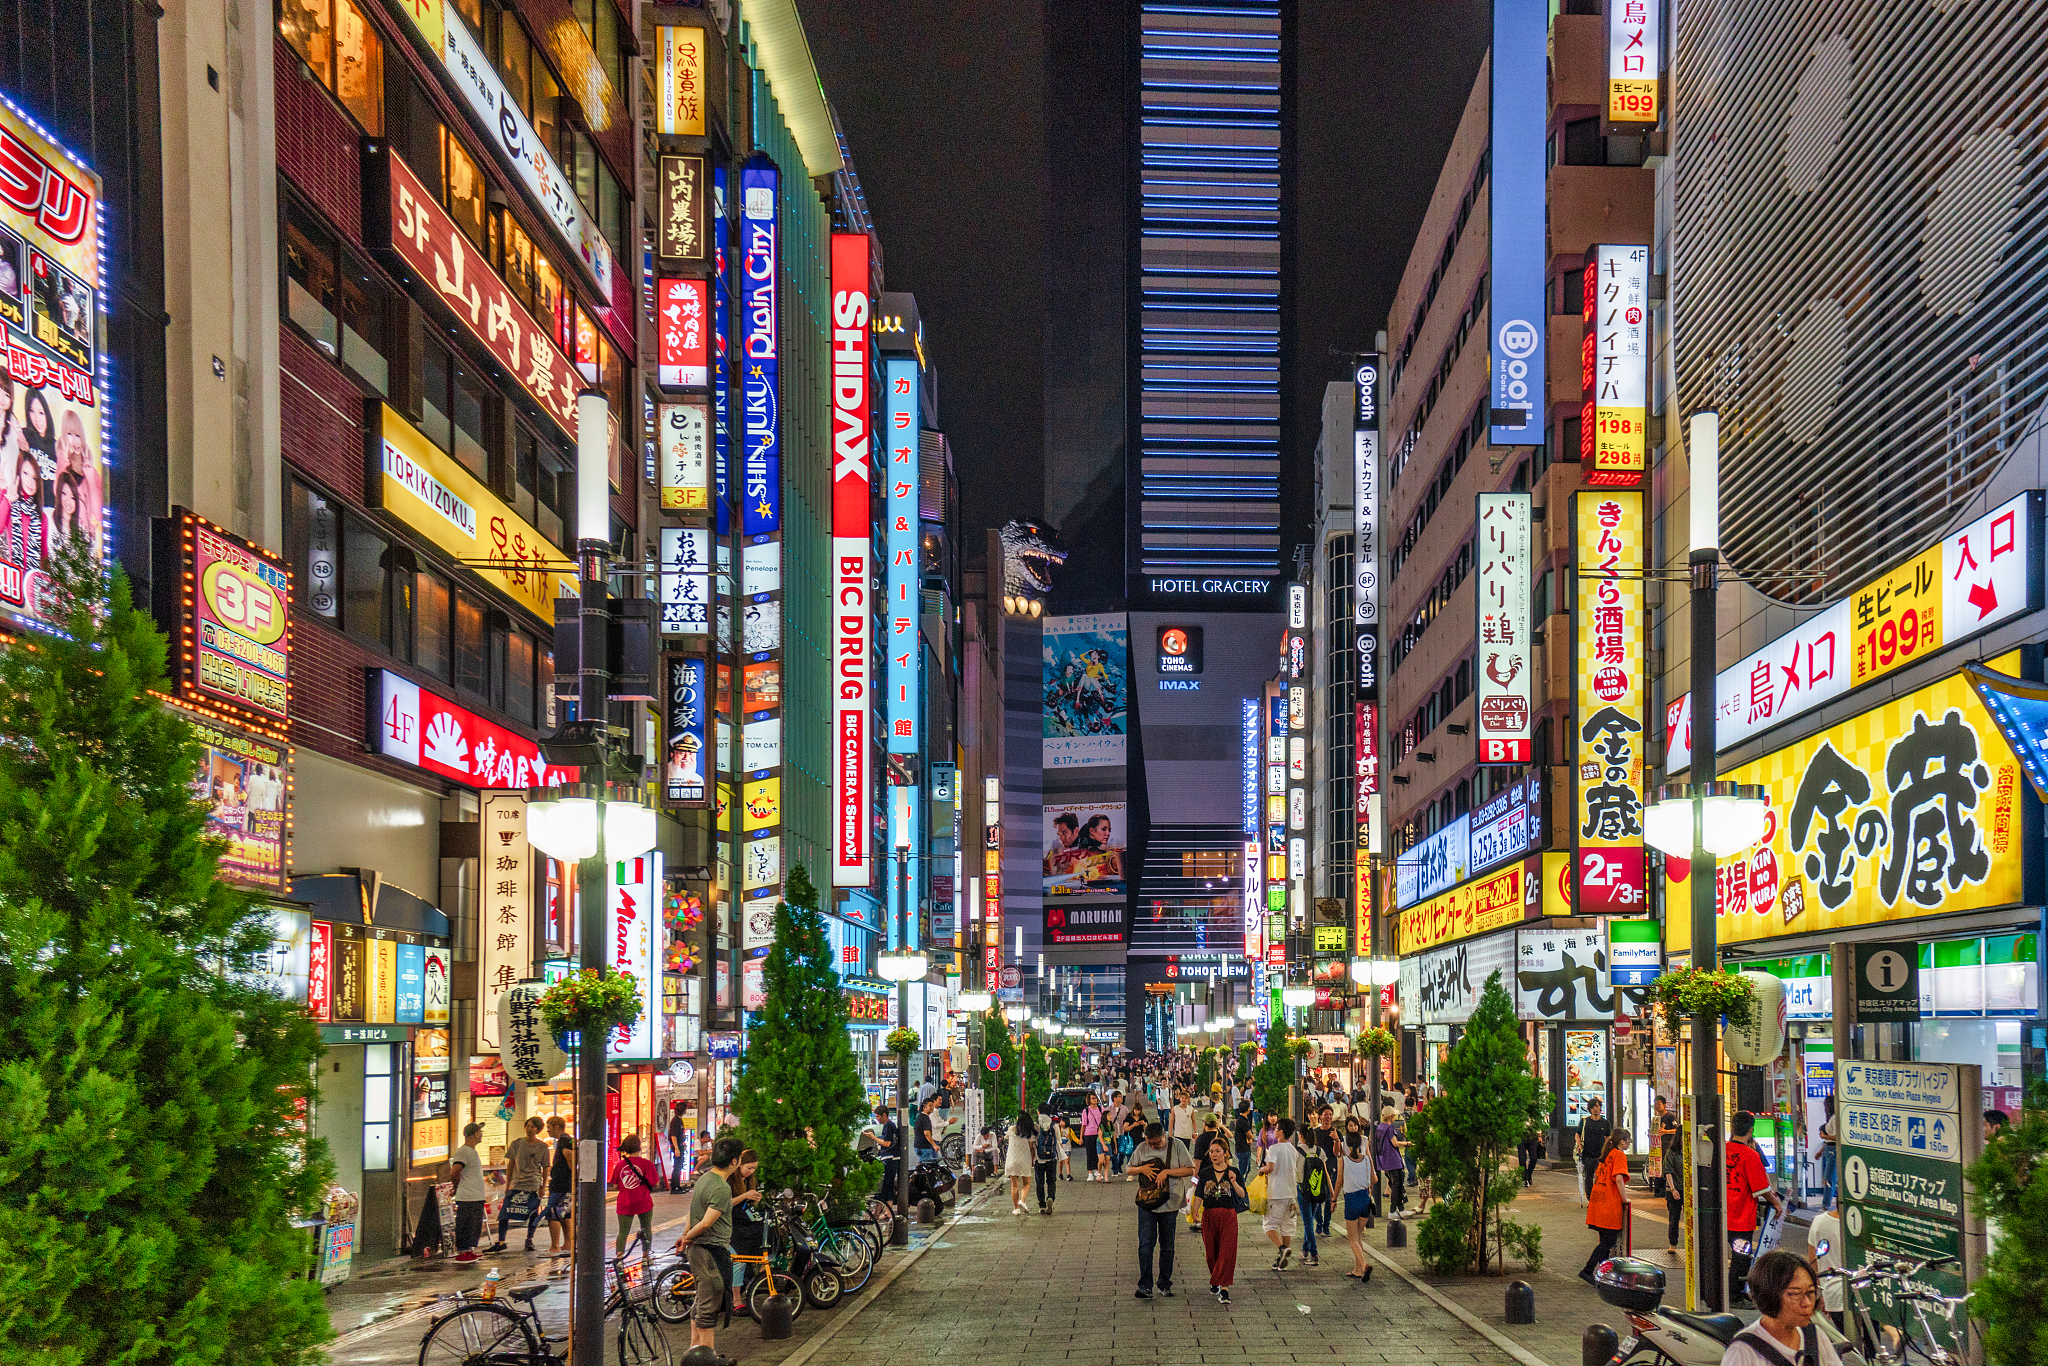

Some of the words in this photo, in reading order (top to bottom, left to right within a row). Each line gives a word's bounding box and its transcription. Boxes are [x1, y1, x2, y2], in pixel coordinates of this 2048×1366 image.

[1623, 1, 1647, 73] 鳥メロ
[1613, 83, 1653, 94] 生ビール
[1619, 95, 1653, 111] 199
[399, 184, 429, 253] 5F
[667, 160, 697, 245] 山内農場
[675, 244, 690, 256] 5F
[1629, 250, 1646, 263] 4F
[683, 300, 701, 350] 焼肉屋
[1601, 258, 1621, 400] キタノイチバ
[673, 368, 693, 384] 4F
[834, 290, 868, 483] SHIDAX
[1357, 366, 1376, 420] Booth
[746, 381, 768, 497] SHINJUKU
[1599, 420, 1631, 434] 198
[1599, 451, 1631, 465] 298
[1601, 442, 1630, 450] 生ビール
[673, 489, 697, 504] 3F
[199, 530, 251, 573] モモカフェ
[1954, 509, 2015, 582] 入口
[840, 556, 863, 606] BIC
[1152, 580, 1199, 593] HOTEL
[1202, 580, 1270, 593] GRACERY
[1594, 501, 1625, 665] きんくら酒場
[1857, 561, 1934, 631] 生ビール
[217, 573, 271, 629] 3F
[218, 629, 285, 674] 03-3200-4466
[1867, 609, 1919, 672] 199
[840, 615, 863, 700] DRUG
[1357, 634, 1376, 688] Booth
[1598, 669, 1619, 678] KIN
[201, 651, 286, 716] 出会い喫茶
[1159, 681, 1200, 690] IMAX
[1597, 687, 1626, 697] KURA
[1746, 631, 1836, 725] 鳥メロ
[673, 663, 698, 729] 海の家
[384, 693, 415, 744] 4F
[845, 715, 857, 737] BIC
[1667, 704, 1680, 726] 6F
[1488, 741, 1519, 760] B1
[1581, 706, 1643, 841] 金の蔵
[1530, 781, 1539, 803] 4F
[1791, 710, 1990, 910] 金の蔵
[1530, 815, 1540, 840] 3F
[1583, 854, 1623, 886] 2F
[1757, 873, 1769, 885] no
[1525, 872, 1539, 905] 2F
[616, 888, 637, 970] Miami
[1070, 910, 1122, 924] MARUHAN
[1409, 895, 1463, 946] やきとりセンター
[1613, 949, 1657, 958] FamilyMart
[1180, 966, 1209, 976] TOHO
[1629, 971, 1642, 984] 酒
[1865, 1067, 1948, 1090] 東京都健康プラザハイジア
[1847, 1087, 1862, 1096] 300m
[1872, 1088, 1887, 1099] Tokyo
[1888, 1089, 1905, 1099] Kenko
[1906, 1091, 1921, 1101] Plaza
[1922, 1092, 1941, 1104] Hygeia
[1848, 1111, 1902, 1133] 新宿区役所
[1849, 1130, 1872, 1143] Shinjuku
[1873, 1133, 1884, 1145] City
[1885, 1134, 1903, 1147] Office
[1929, 1141, 1949, 1153] 150m
[1869, 1166, 1946, 1195] 新宿区エリアマップ
[1869, 1183, 1902, 1202] Shinjuku
[1902, 1190, 1918, 1206] City
[1919, 1194, 1939, 1210] Area
[1939, 1198, 1958, 1216] Map
